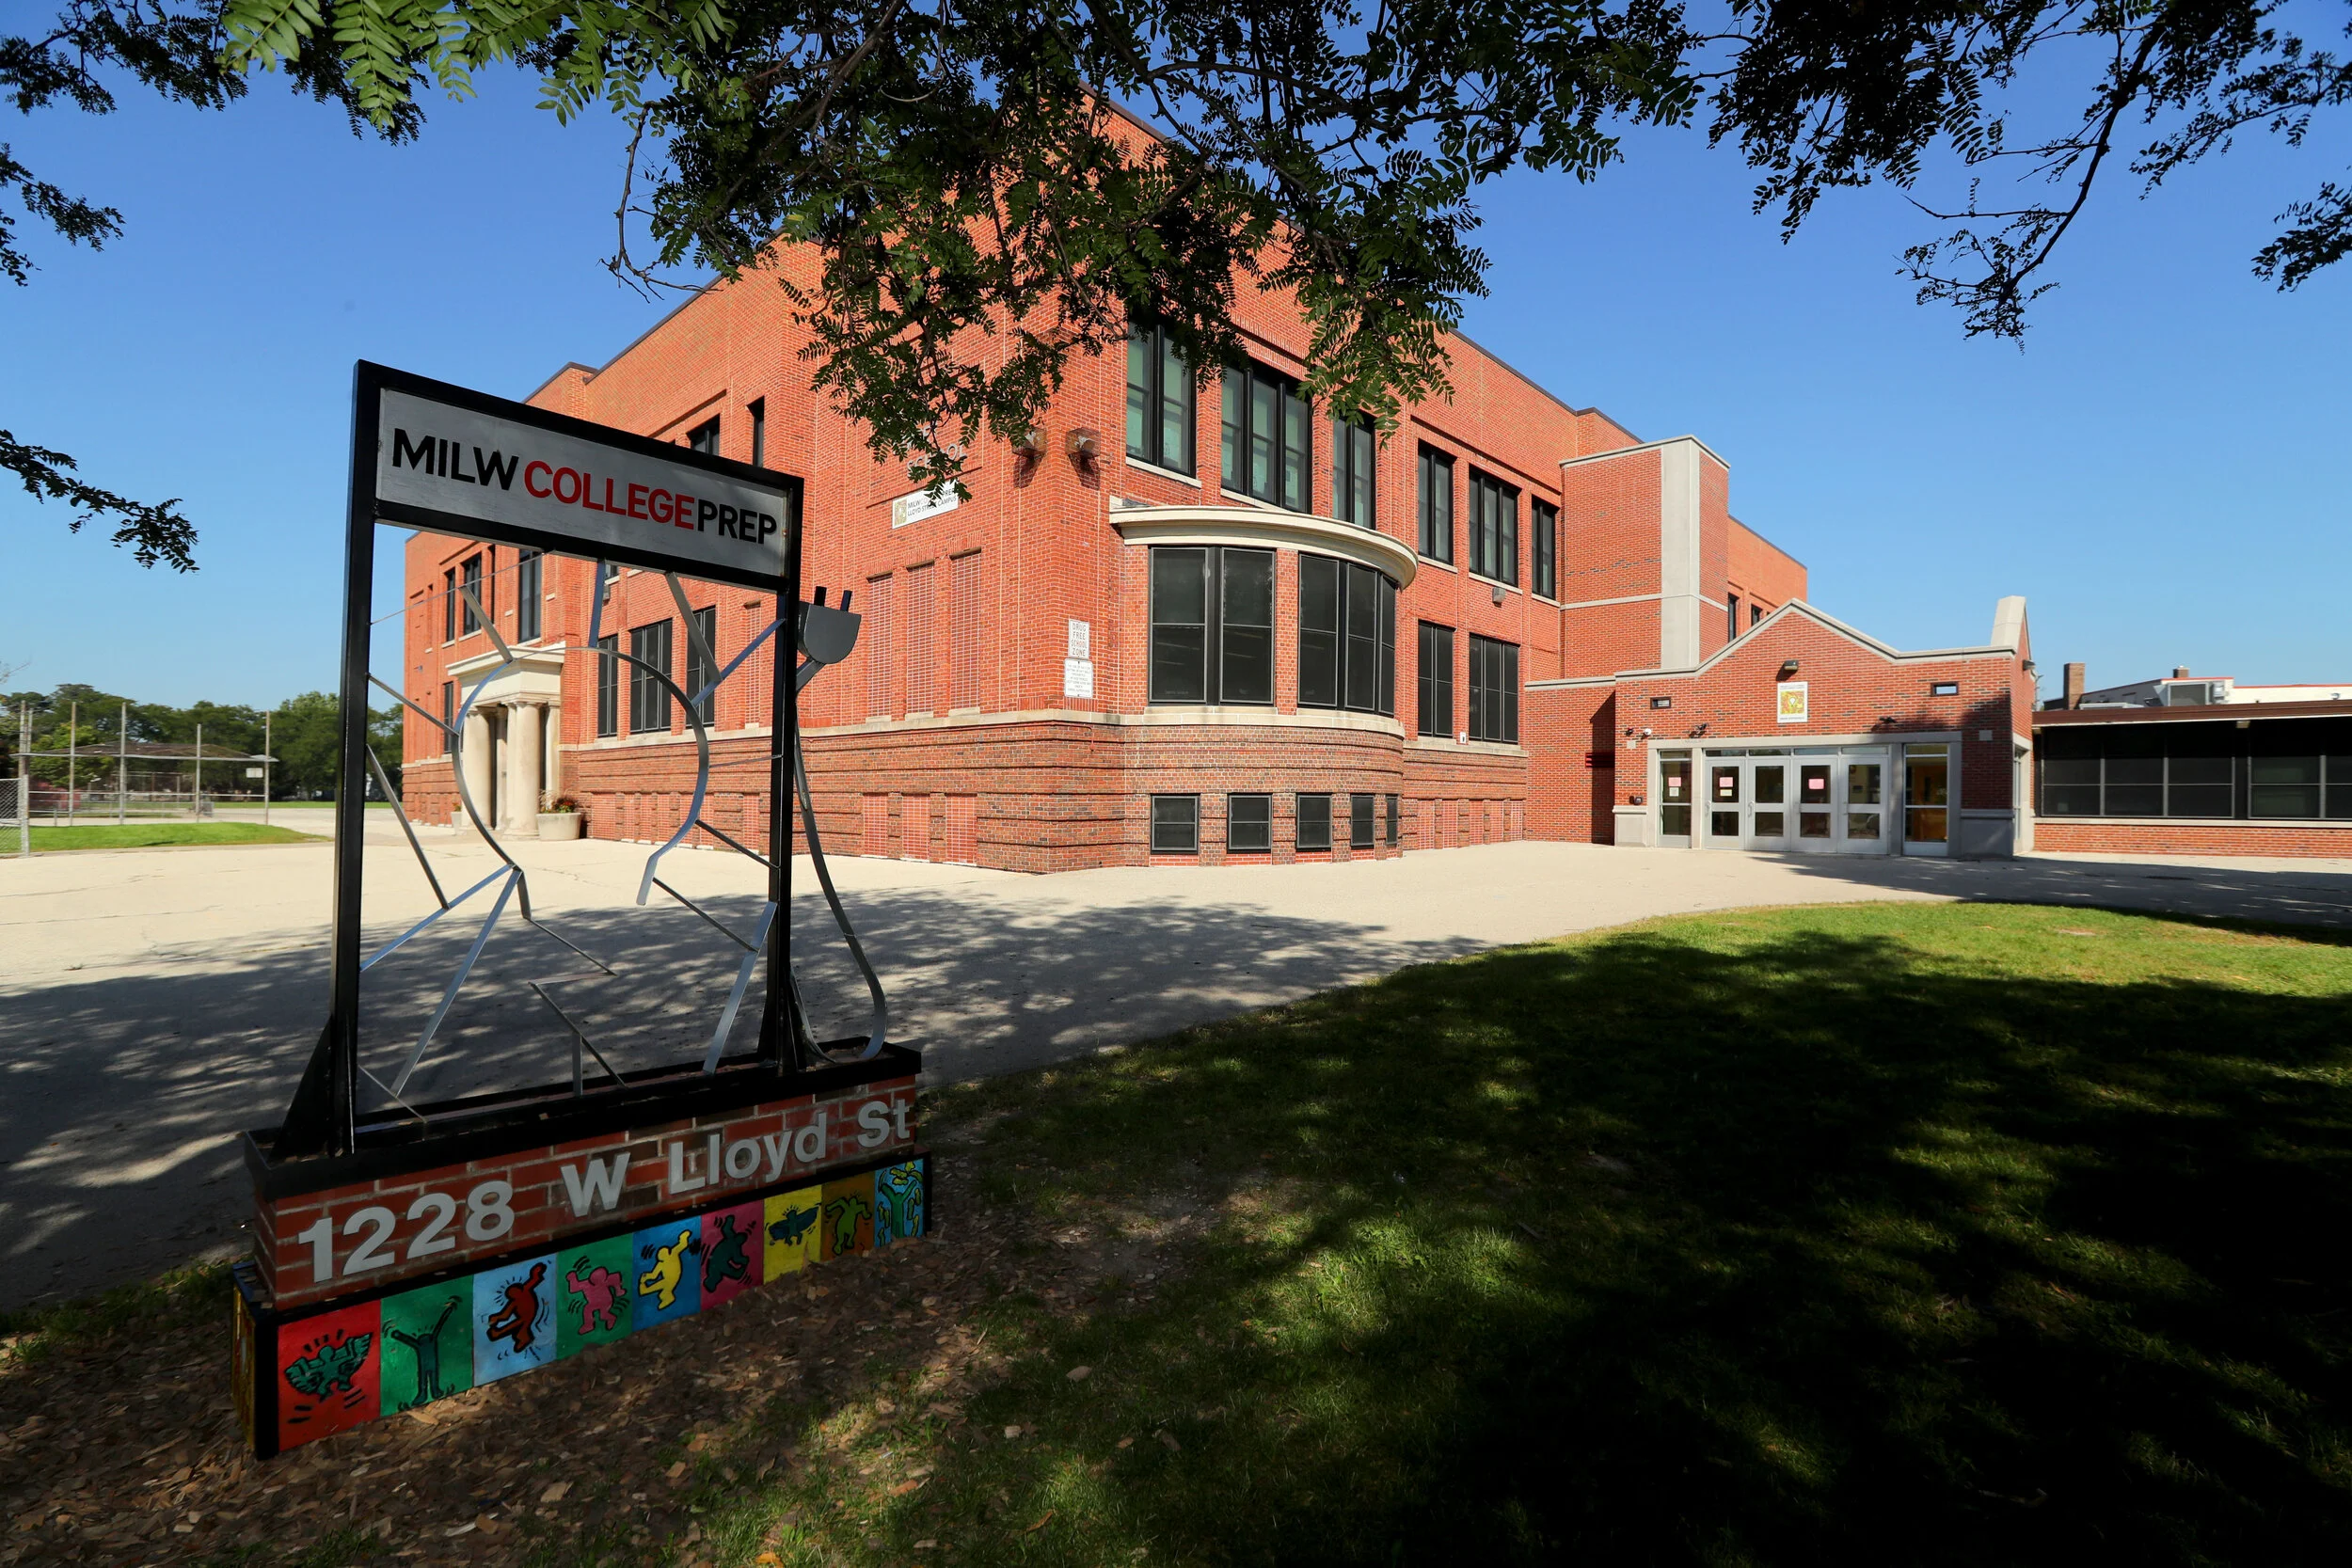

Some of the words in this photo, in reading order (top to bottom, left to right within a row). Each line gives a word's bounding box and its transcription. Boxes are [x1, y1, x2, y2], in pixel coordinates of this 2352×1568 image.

[392, 428, 519, 491] MILW
[524, 460, 694, 531] COLLEGE
[696, 499, 777, 545] PREP
[937, 496, 957, 507] CAMPUS
[1072, 623, 1087, 632] DRUG
[1073, 631, 1086, 641] FREE
[1071, 639, 1088, 649] SCHOOL
[1072, 647, 1086, 657] ZONE
[297, 1180, 515, 1283] 1228
[561, 1152, 631, 1217] W
[668, 1113, 827, 1195] Lloyd
[857, 1099, 911, 1148] St
